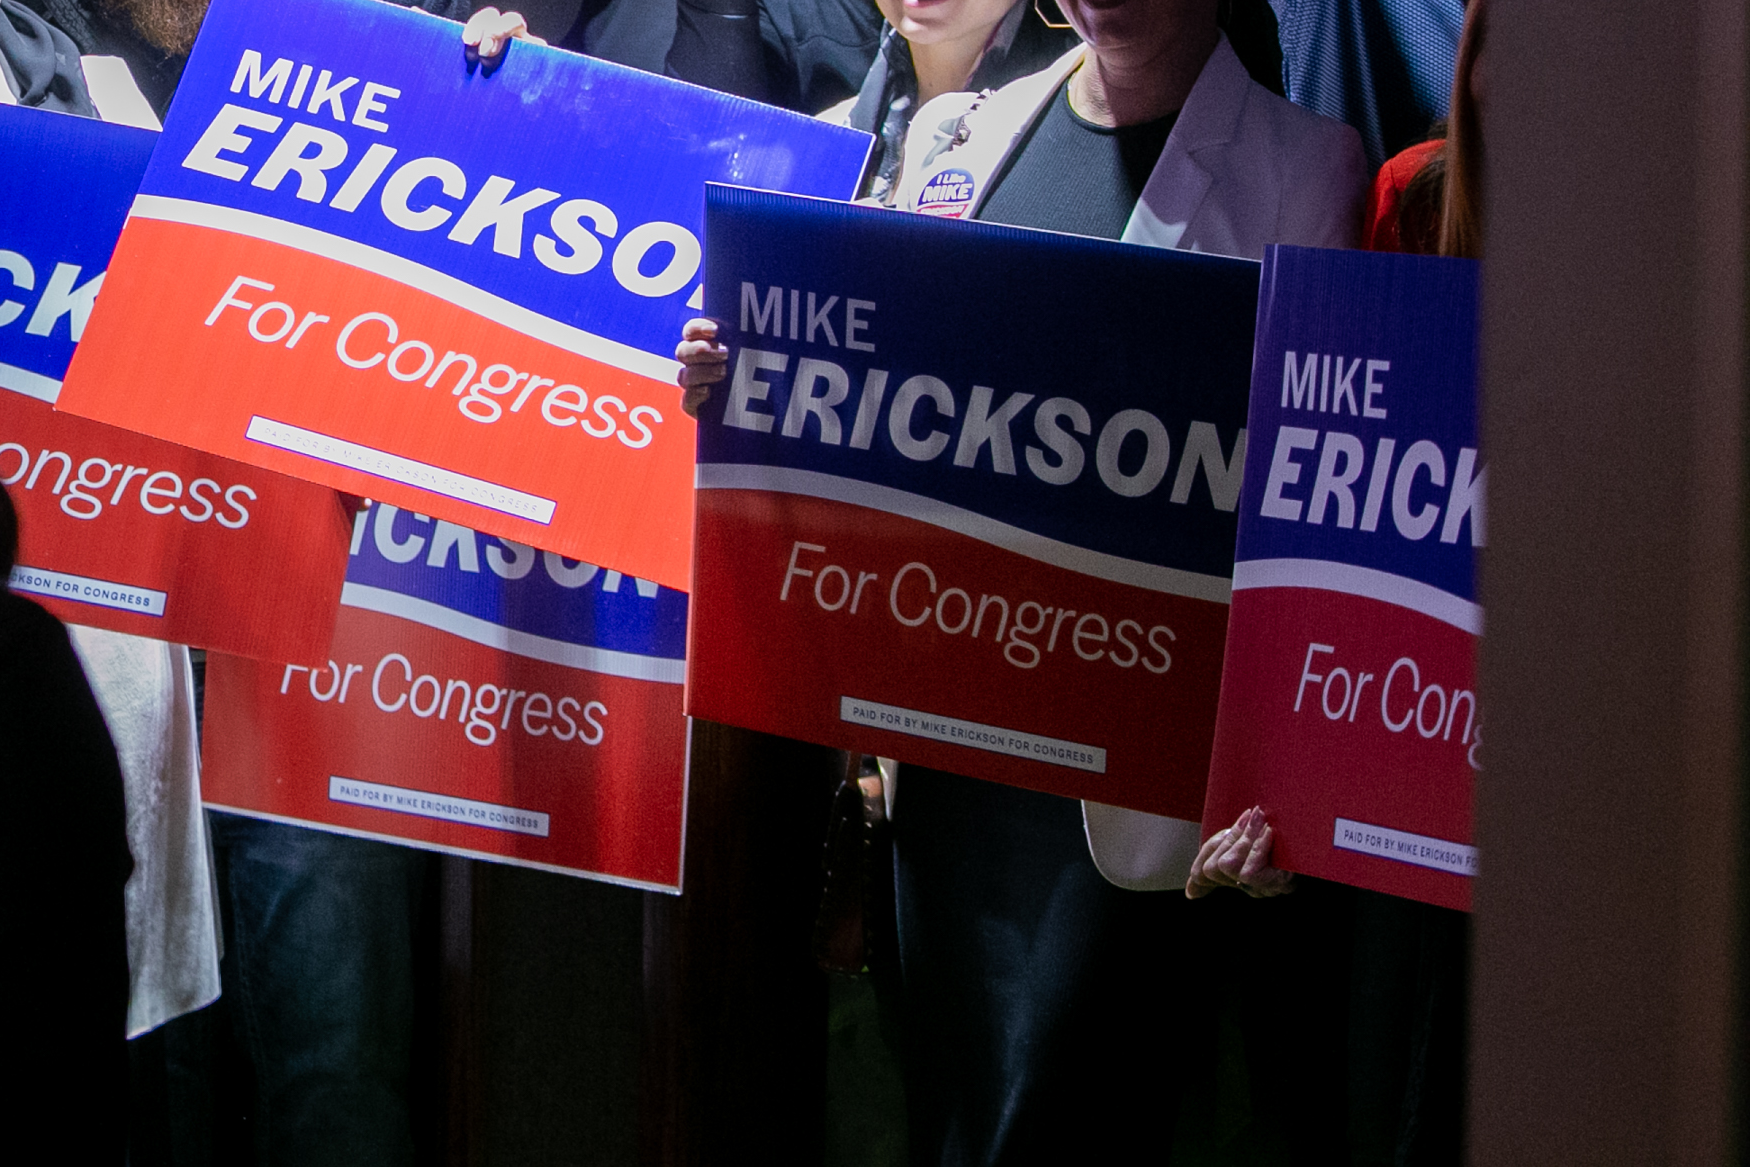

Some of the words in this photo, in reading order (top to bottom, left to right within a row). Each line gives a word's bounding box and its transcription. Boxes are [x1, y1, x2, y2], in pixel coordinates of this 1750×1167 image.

[231, 50, 400, 132] MIKE
[181, 102, 704, 308] ERICKSO
[922, 183, 973, 202] MIKE
[740, 282, 875, 351] MIKE
[205, 276, 330, 348] For
[336, 312, 663, 448] Congress
[1281, 351, 1389, 418] MIKE
[723, 347, 1247, 514] ERICKSON
[1259, 426, 1486, 548] ERICK
[11, 573, 51, 588] CKSON
[55, 581, 79, 593] FOR
[84, 587, 151, 606] CONGRESS
[780, 542, 877, 614] For
[890, 562, 1175, 673] Congress
[371, 652, 610, 748] Congress
[1293, 642, 1374, 723] For
[853, 707, 877, 720] PAID
[881, 712, 901, 726] FOR
[905, 717, 918, 729] BY
[921, 721, 947, 735] MIKE
[951, 727, 1005, 746] ERICKSON
[1009, 738, 1030, 751] FOR
[1033, 743, 1094, 764] CONGRESS
[340, 786, 360, 797] PAID
[363, 790, 380, 800] FOR
[382, 793, 393, 802] BY
[397, 796, 418, 808] MIKE
[421, 800, 466, 816] ERICKSON
[469, 809, 486, 819] FOR
[489, 812, 539, 828] CONGRESS
[1344, 830, 1362, 843] PAID
[1365, 834, 1382, 847] FOR
[1384, 839, 1395, 849] BY
[1397, 842, 1418, 855] MIKE
[1420, 847, 1463, 865] ERICKSON
[1466, 856, 1478, 867] FO
